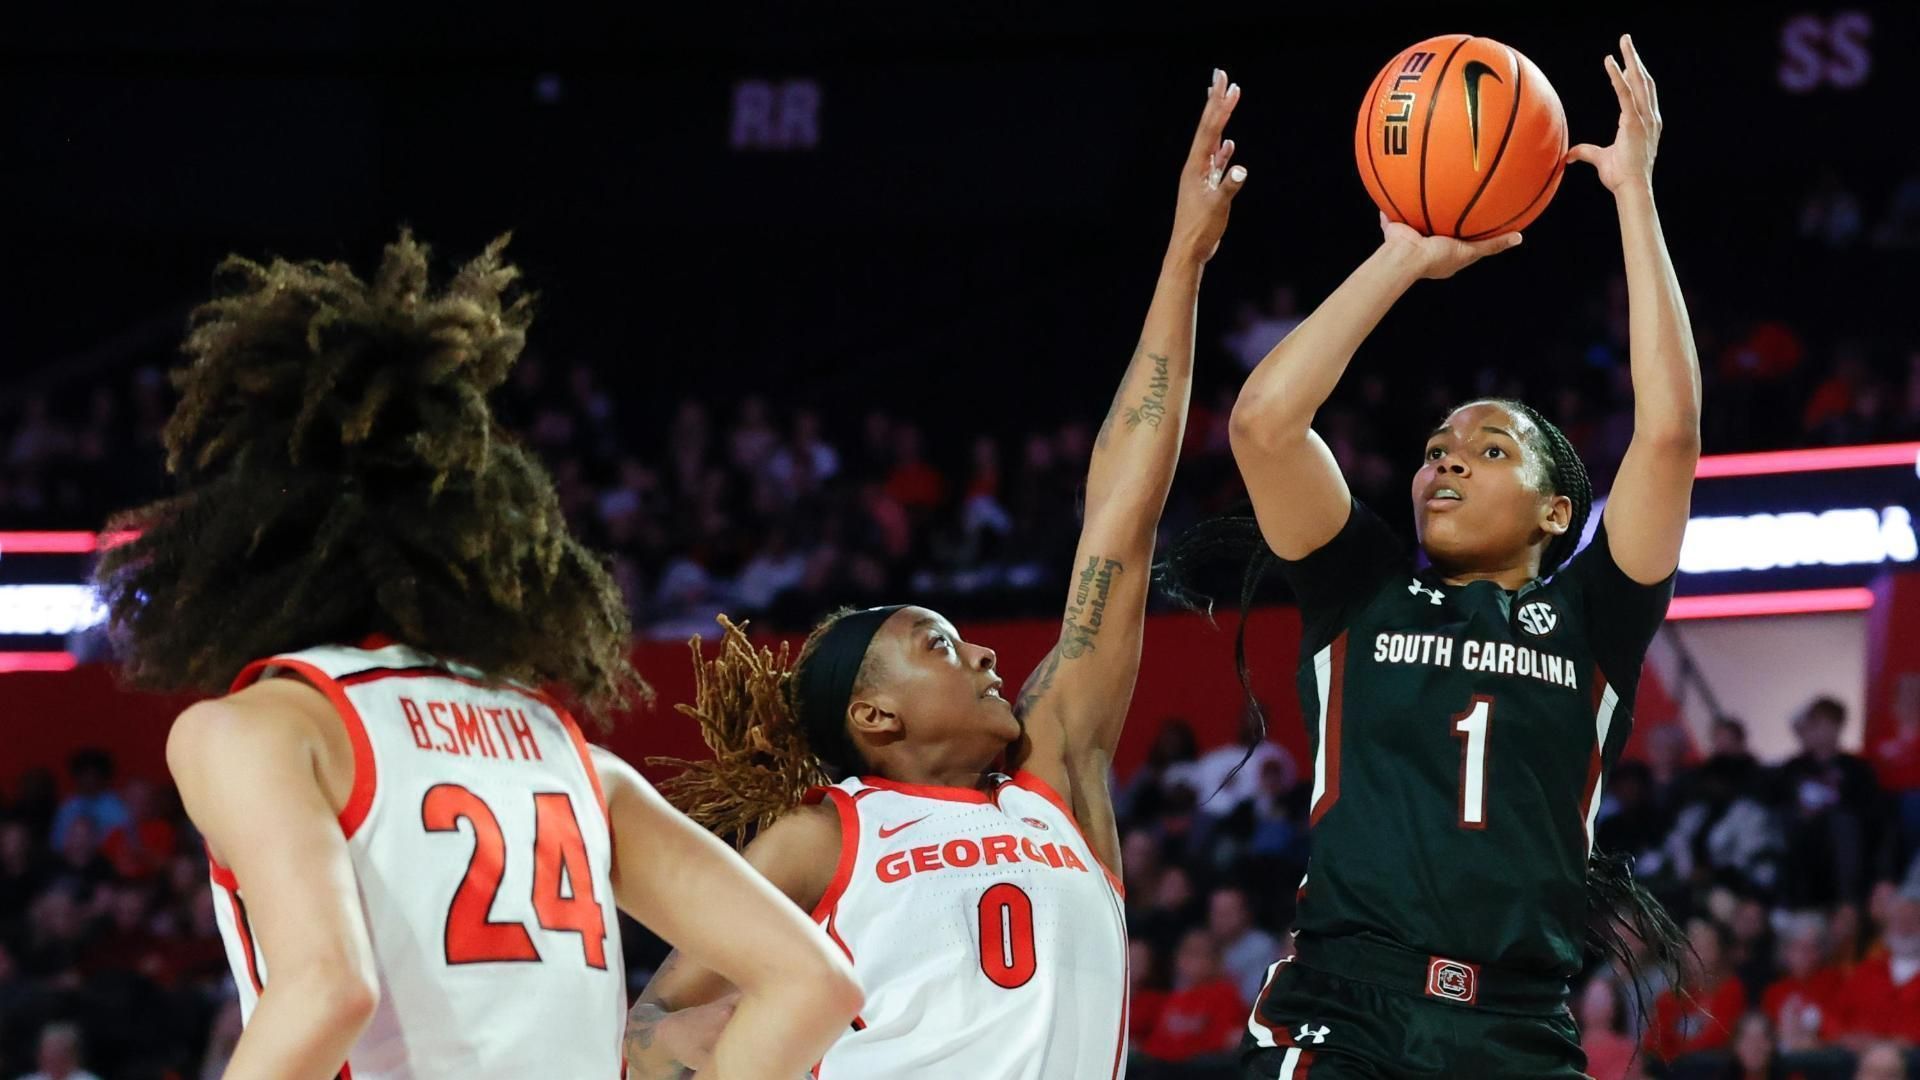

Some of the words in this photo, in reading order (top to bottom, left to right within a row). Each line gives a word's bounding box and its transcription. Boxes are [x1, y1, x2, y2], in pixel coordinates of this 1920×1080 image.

[1779, 13, 1870, 90] SS
[1384, 51, 1437, 156] ELITE
[1074, 558, 1124, 652] Mentality
[1517, 602, 1557, 635] SEC
[1374, 633, 1453, 667] SOUTH
[1462, 640, 1578, 690] CAROLINA
[398, 696, 543, 761] B.SMITH
[1450, 694, 1495, 829] 1
[421, 783, 608, 971] 24
[875, 834, 1089, 884] GEORGIA
[978, 882, 1037, 990] 0
